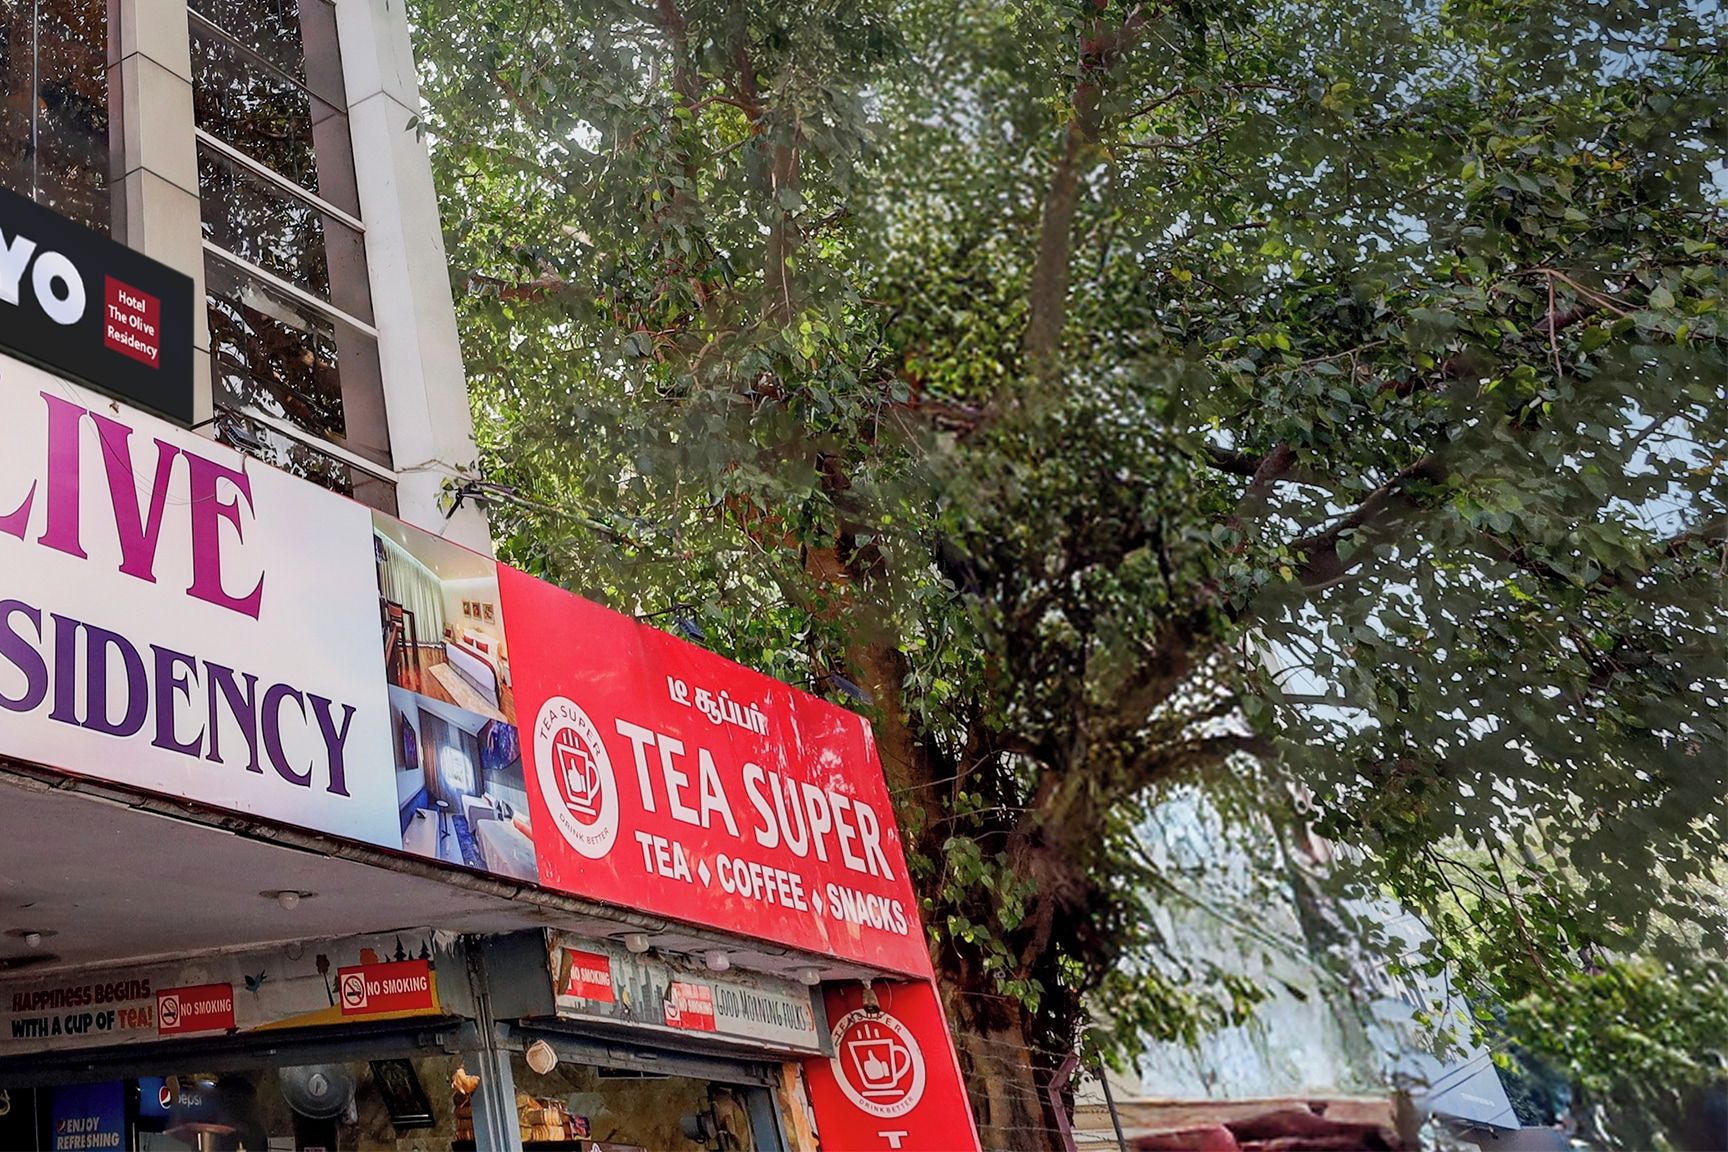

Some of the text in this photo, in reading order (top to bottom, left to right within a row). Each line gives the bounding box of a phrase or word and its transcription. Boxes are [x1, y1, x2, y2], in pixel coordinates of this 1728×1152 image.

[118, 289, 146, 313] Hotel
[108, 304, 155, 336] The Olive
[107, 325, 158, 360] Residency
[539, 705, 601, 757] TEA SUPER
[615, 718, 895, 881] TEA SUPER
[559, 812, 610, 846] DRINK BETTER
[635, 831, 908, 935] TEA COFFEE SNACKS
[367, 976, 427, 996] NO SMOKING
[581, 966, 610, 986] SMOKING
[180, 999, 232, 1016] NO SMOKING
[12, 1014, 49, 1038] WITH
[51, 1015, 62, 1036] A
[64, 1012, 91, 1035] CUP
[95, 1010, 115, 1032] OF
[67, 1117, 100, 1133] ENJOY
[57, 1132, 120, 1150] REFRESHING
